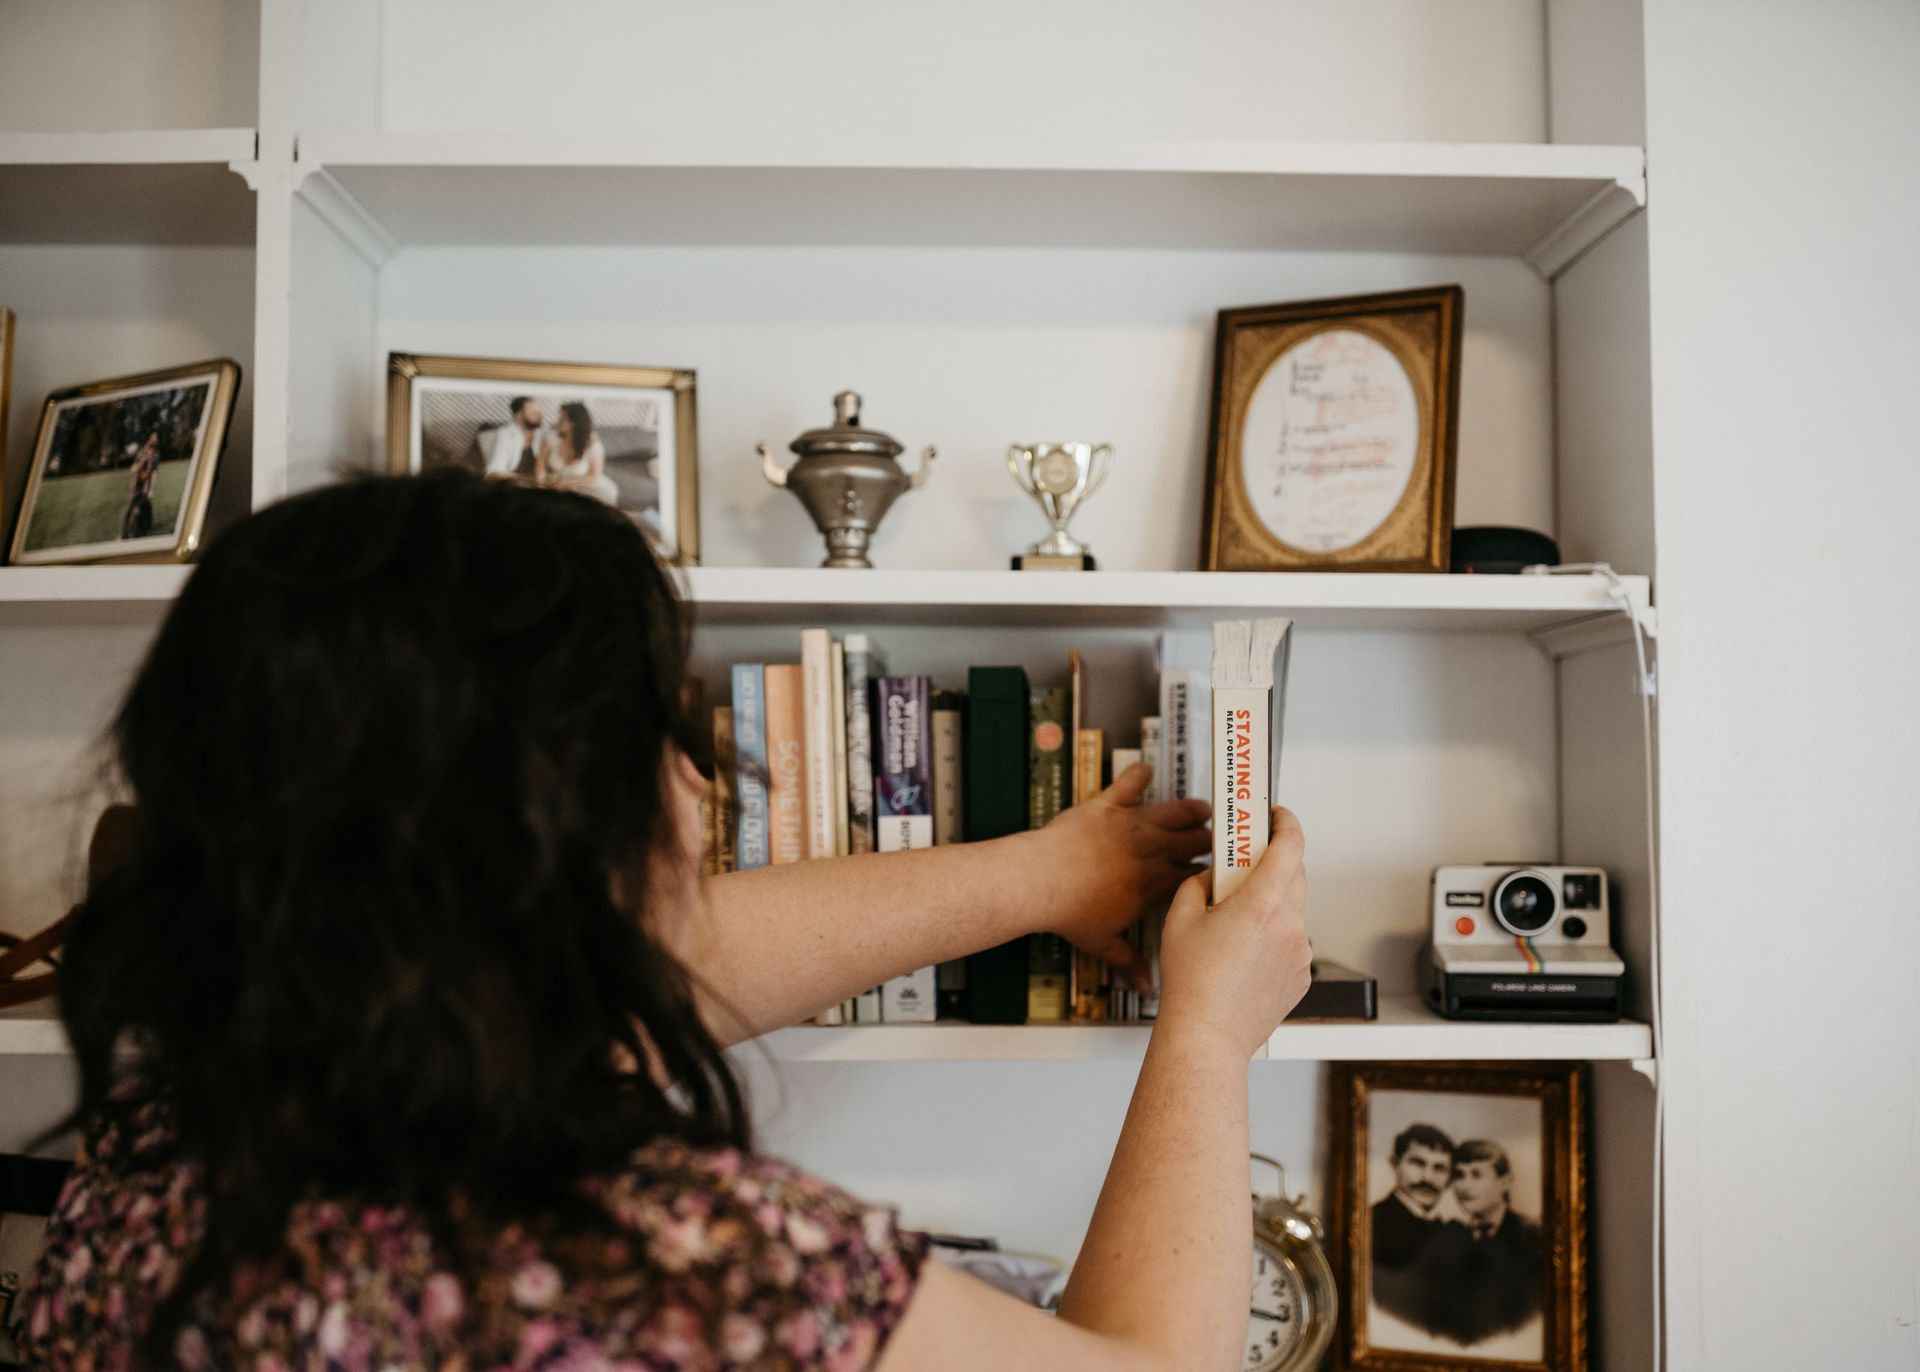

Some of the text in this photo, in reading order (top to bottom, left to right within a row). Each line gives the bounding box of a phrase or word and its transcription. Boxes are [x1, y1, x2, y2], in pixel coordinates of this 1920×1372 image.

[887, 694, 904, 774] Goldman
[1176, 682, 1187, 746] STRONG
[1226, 710, 1234, 868] REAL POEMS FOR UNREAL TIMES
[1236, 709, 1250, 868] STAYING ALIVE
